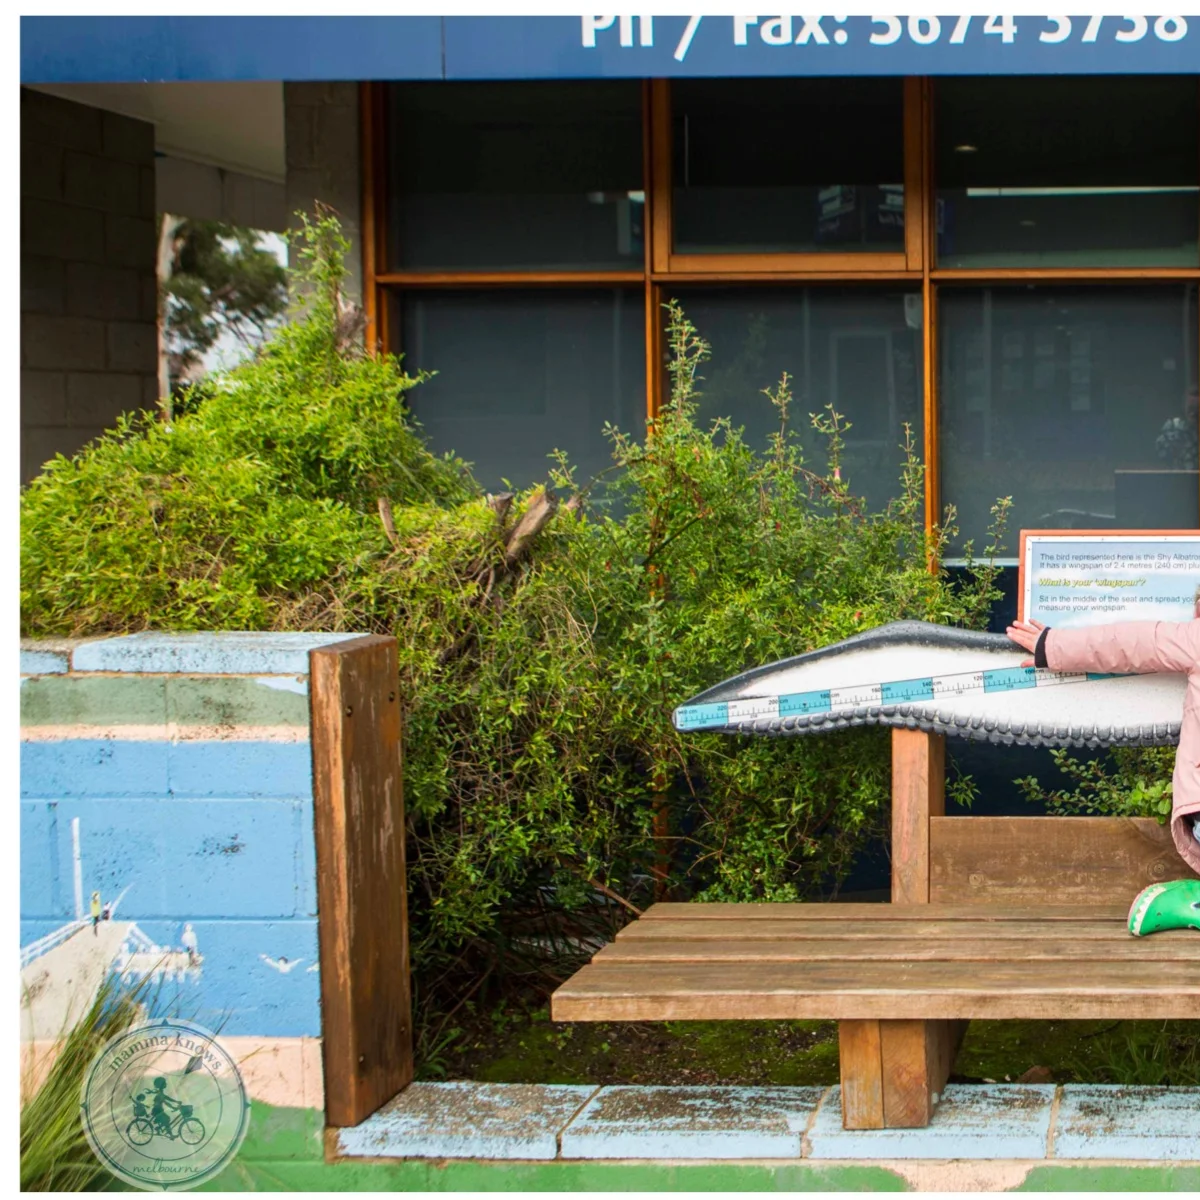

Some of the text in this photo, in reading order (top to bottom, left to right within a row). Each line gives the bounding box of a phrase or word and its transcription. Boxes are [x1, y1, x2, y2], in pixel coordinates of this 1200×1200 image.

[581, 15, 653, 47] Ph
[674, 15, 702, 61] /
[733, 15, 849, 45] Fax:
[1041, 553, 1054, 561] The
[1056, 553, 1070, 561] bird
[1072, 553, 1116, 562] represented
[1117, 553, 1134, 561] here
[1135, 553, 1142, 561] is
[1143, 553, 1155, 561] the
[1157, 553, 1171, 562] Shy
[1069, 562, 1103, 571] wingspan
[1154, 562, 1171, 570] (240
[1172, 562, 1187, 570] cm)
[1038, 578, 1062, 587] What
[1063, 578, 1071, 586] is
[1072, 579, 1093, 588] your
[1039, 595, 1049, 603] Sit
[1059, 595, 1071, 603] the
[1072, 595, 1097, 603] middle
[1154, 595, 1180, 605] spread
[1072, 604, 1089, 613] your
